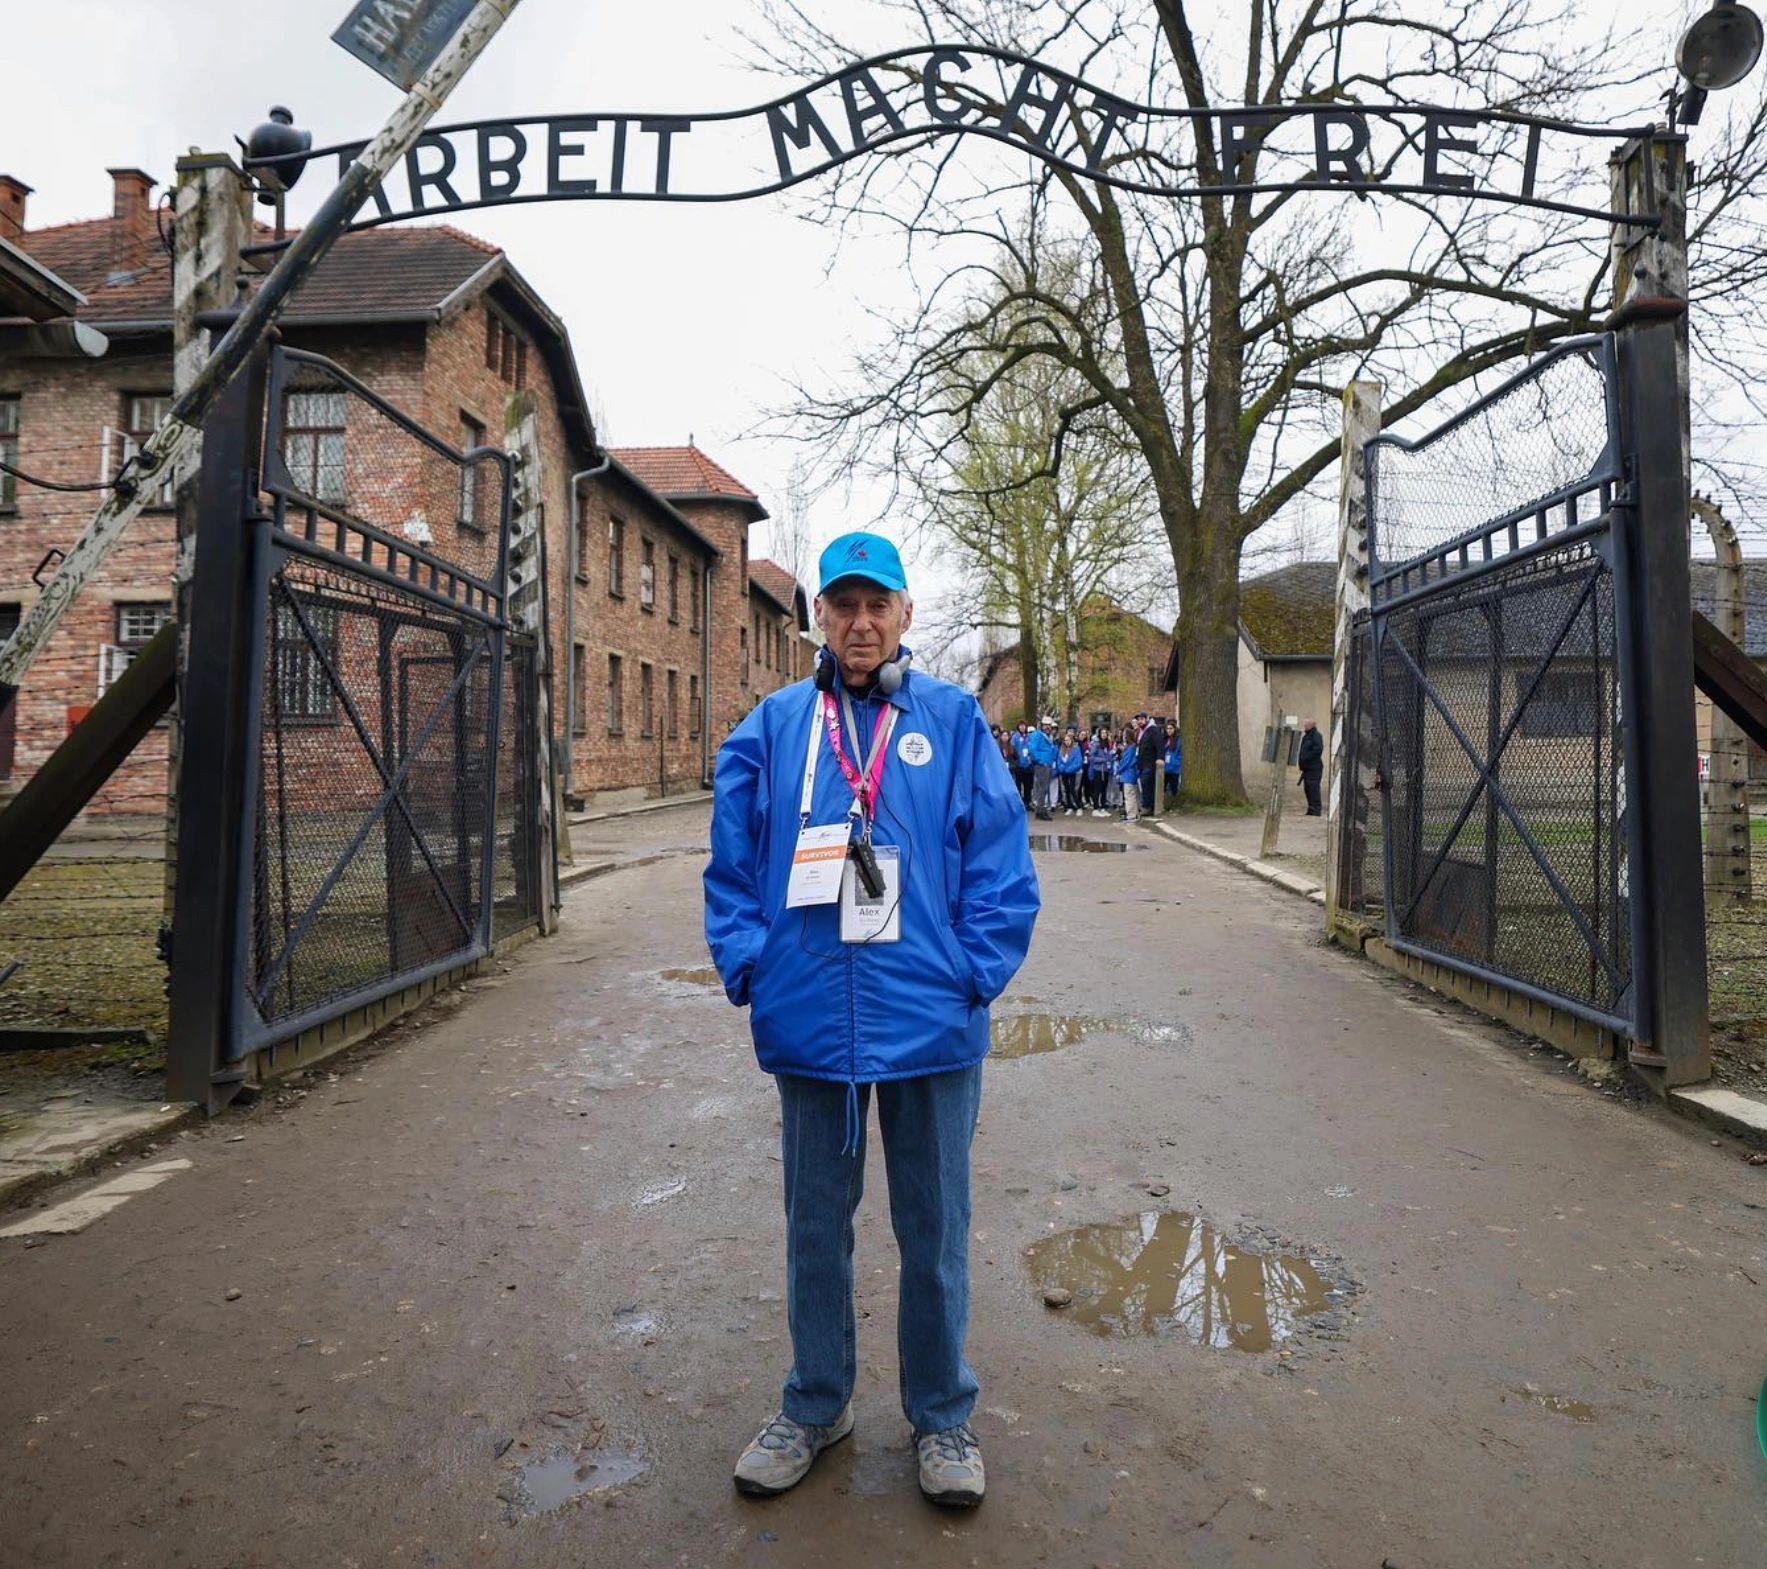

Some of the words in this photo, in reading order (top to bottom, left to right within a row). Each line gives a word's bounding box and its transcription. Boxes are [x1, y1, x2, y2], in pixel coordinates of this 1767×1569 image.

[766, 48, 1140, 182] MACHT
[1219, 111, 1542, 198] FREI
[859, 908, 880, 916] Alex
